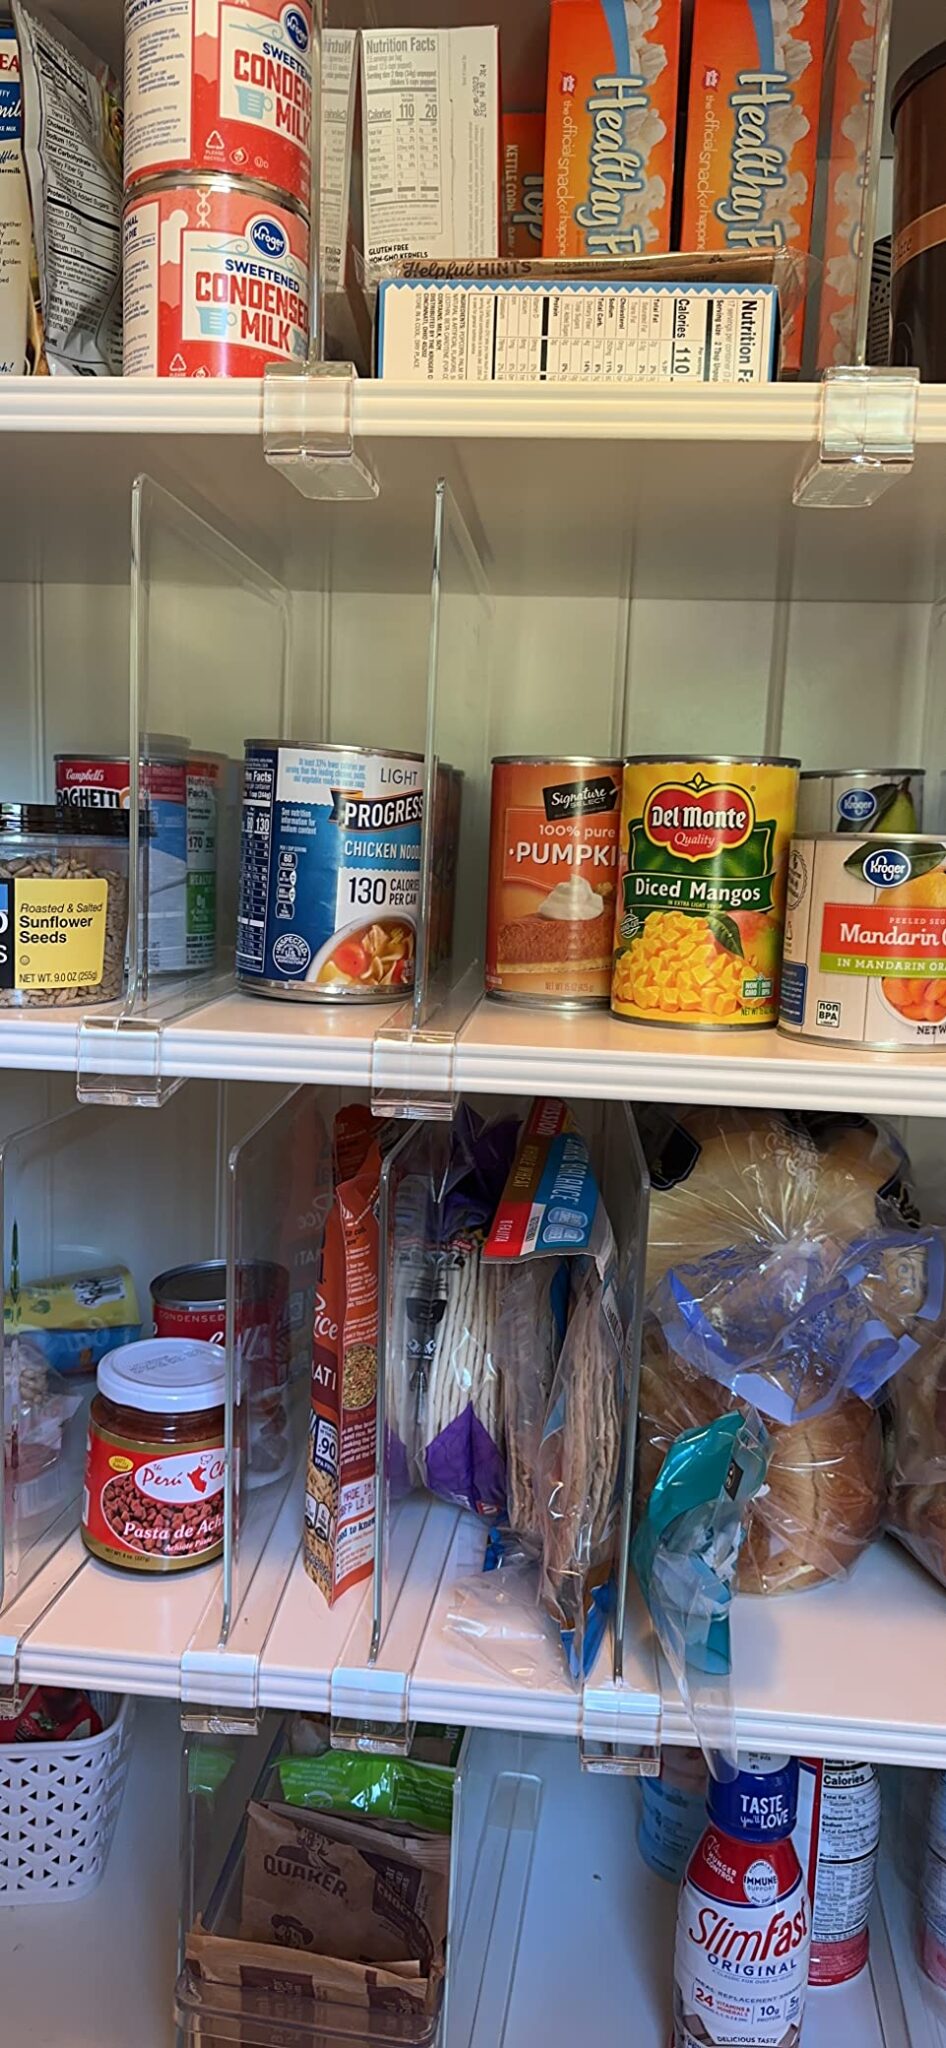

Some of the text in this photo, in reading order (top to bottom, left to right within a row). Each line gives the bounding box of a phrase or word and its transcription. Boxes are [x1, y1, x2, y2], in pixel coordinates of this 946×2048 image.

[287, 11, 308, 46] Kroger
[366, 37, 436, 54] Nutrition Facts
[399, 104, 415, 118] 110
[425, 104, 438, 118] 20
[563, 101, 571, 116] the
[706, 95, 716, 109] the
[562, 117, 578, 157] official
[704, 110, 720, 151] official
[576, 78, 648, 228] Healthy
[716, 73, 792, 222] Healthy
[506, 145, 519, 181] KETTLE
[556, 158, 576, 206] snack
[697, 151, 716, 197] snack
[253, 226, 284, 251] Kroger
[369, 244, 409, 255] GLUTEN FREE
[400, 251, 429, 260] KERNELS
[225, 259, 299, 293] SWEETENED
[402, 261, 532, 279] Helpful HINTS
[428, 293, 437, 330] DISTRIBUTED
[436, 293, 444, 321] CONTAINS:
[458, 293, 467, 329] INGREDIENTS:
[552, 297, 560, 317] Protein
[619, 298, 627, 329] Cholesterol
[652, 299, 660, 313] Total
[596, 313, 604, 328] Carb.
[714, 300, 723, 336] Serving size
[240, 310, 291, 353] MILK
[675, 299, 691, 374] Calories 110
[739, 300, 758, 364] Nutrition
[427, 351, 435, 374] KROGER
[65, 768, 105, 783] Campbell's
[253, 770, 272, 782] Facts
[380, 768, 418, 787] LIGHT
[551, 787, 607, 809] Signature
[570, 797, 606, 809] SELECT
[843, 796, 873, 815] Kroger
[281, 807, 312, 818] See nutrition
[651, 805, 747, 829] Del Monte
[256, 818, 270, 832] 130
[298, 827, 317, 835] content
[539, 825, 616, 840] 100% pure
[188, 837, 203, 849] 170
[344, 840, 397, 859] CHICKEN
[674, 832, 716, 848] Quality
[283, 854, 293, 862] 60
[870, 854, 907, 881] Kroger
[349, 877, 387, 905] 130
[389, 893, 405, 906] PER
[635, 878, 761, 907] Diced Mangos
[20, 903, 103, 914] Roasted & Salted
[19, 915, 93, 929] Sunflower
[889, 917, 927, 925] PEELED
[19, 931, 67, 944] Seeds
[840, 923, 940, 946] Mandarin
[275, 936, 308, 957] INSPECTED
[837, 958, 926, 971] IN MANDARIN
[19, 974, 35, 983] NET
[38, 973, 53, 982] WT.
[54, 972, 66, 982] 9.0
[66, 972, 77, 981] OZ
[745, 981, 757, 989] NON
[819, 1002, 839, 1011] non
[819, 1011, 837, 1021] BPA
[917, 1025, 937, 1035] NET
[550, 1162, 588, 1204] BALANCE
[159, 1311, 225, 1323] CONDENSED
[142, 1467, 183, 1487] Perú
[123, 1522, 170, 1540] Pasta
[173, 1525, 194, 1540] de
[349, 1525, 358, 1535] to
[823, 1774, 865, 1785] Calories
[740, 1794, 784, 1815] TASTE
[740, 1808, 789, 1829] you'll LOVE
[706, 1857, 735, 1885] CONTROL
[708, 1852, 737, 1878] HUNGER
[264, 1854, 349, 1898] QUAKER
[743, 1875, 777, 1886] IMMUNE
[747, 1884, 776, 1892] SUPPORT
[688, 1896, 807, 1962] SlimFast
[707, 1952, 798, 1977] ORIGINAL
[695, 1987, 780, 2017] 24 VITAMINS 10g
[717, 1991, 778, 2004] REPLACEMENT
[716, 2005, 748, 2018] MINERALS
[717, 2035, 778, 2044] DELICIOUS TASTE
